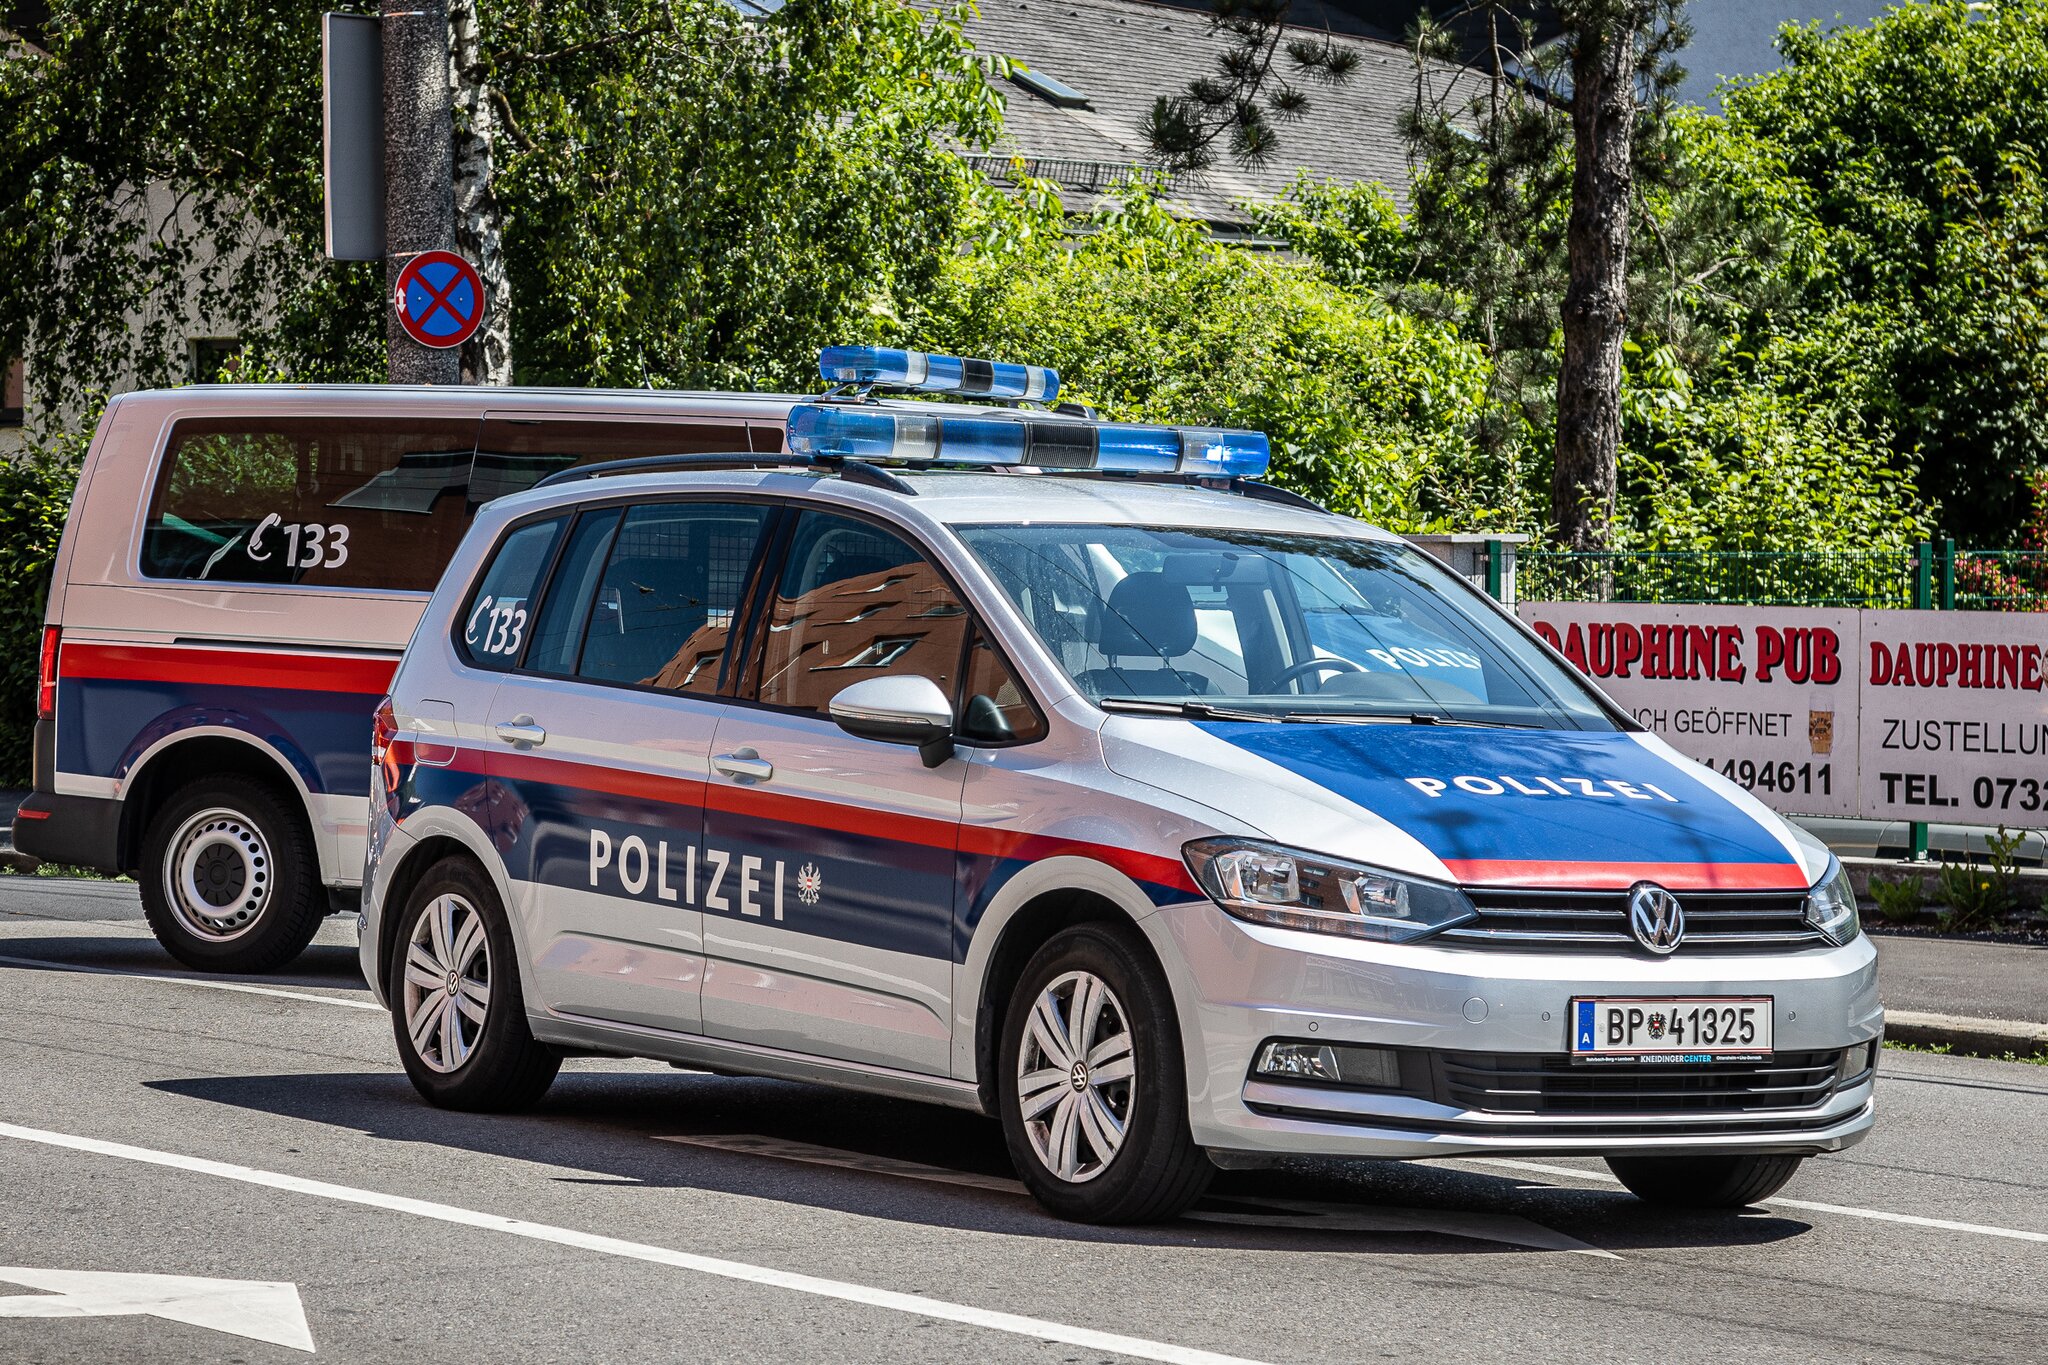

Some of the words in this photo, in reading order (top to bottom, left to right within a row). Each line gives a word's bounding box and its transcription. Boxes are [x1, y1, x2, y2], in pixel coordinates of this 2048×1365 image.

[283, 523, 350, 570] 133
[483, 607, 528, 656] 133
[1755, 625, 1842, 686] PUB
[1869, 641, 2044, 693] DAUPHINE
[1674, 706, 1793, 738] GEÖFFNET
[1404, 775, 1680, 803] POLIZEI
[1695, 757, 1832, 796] 494611
[1879, 772, 1960, 807] TEL.
[589, 828, 786, 922] POLIZEI
[1581, 1032, 1591, 1044] A
[1606, 1007, 1645, 1046] BP
[1667, 1007, 1756, 1046] 41325
